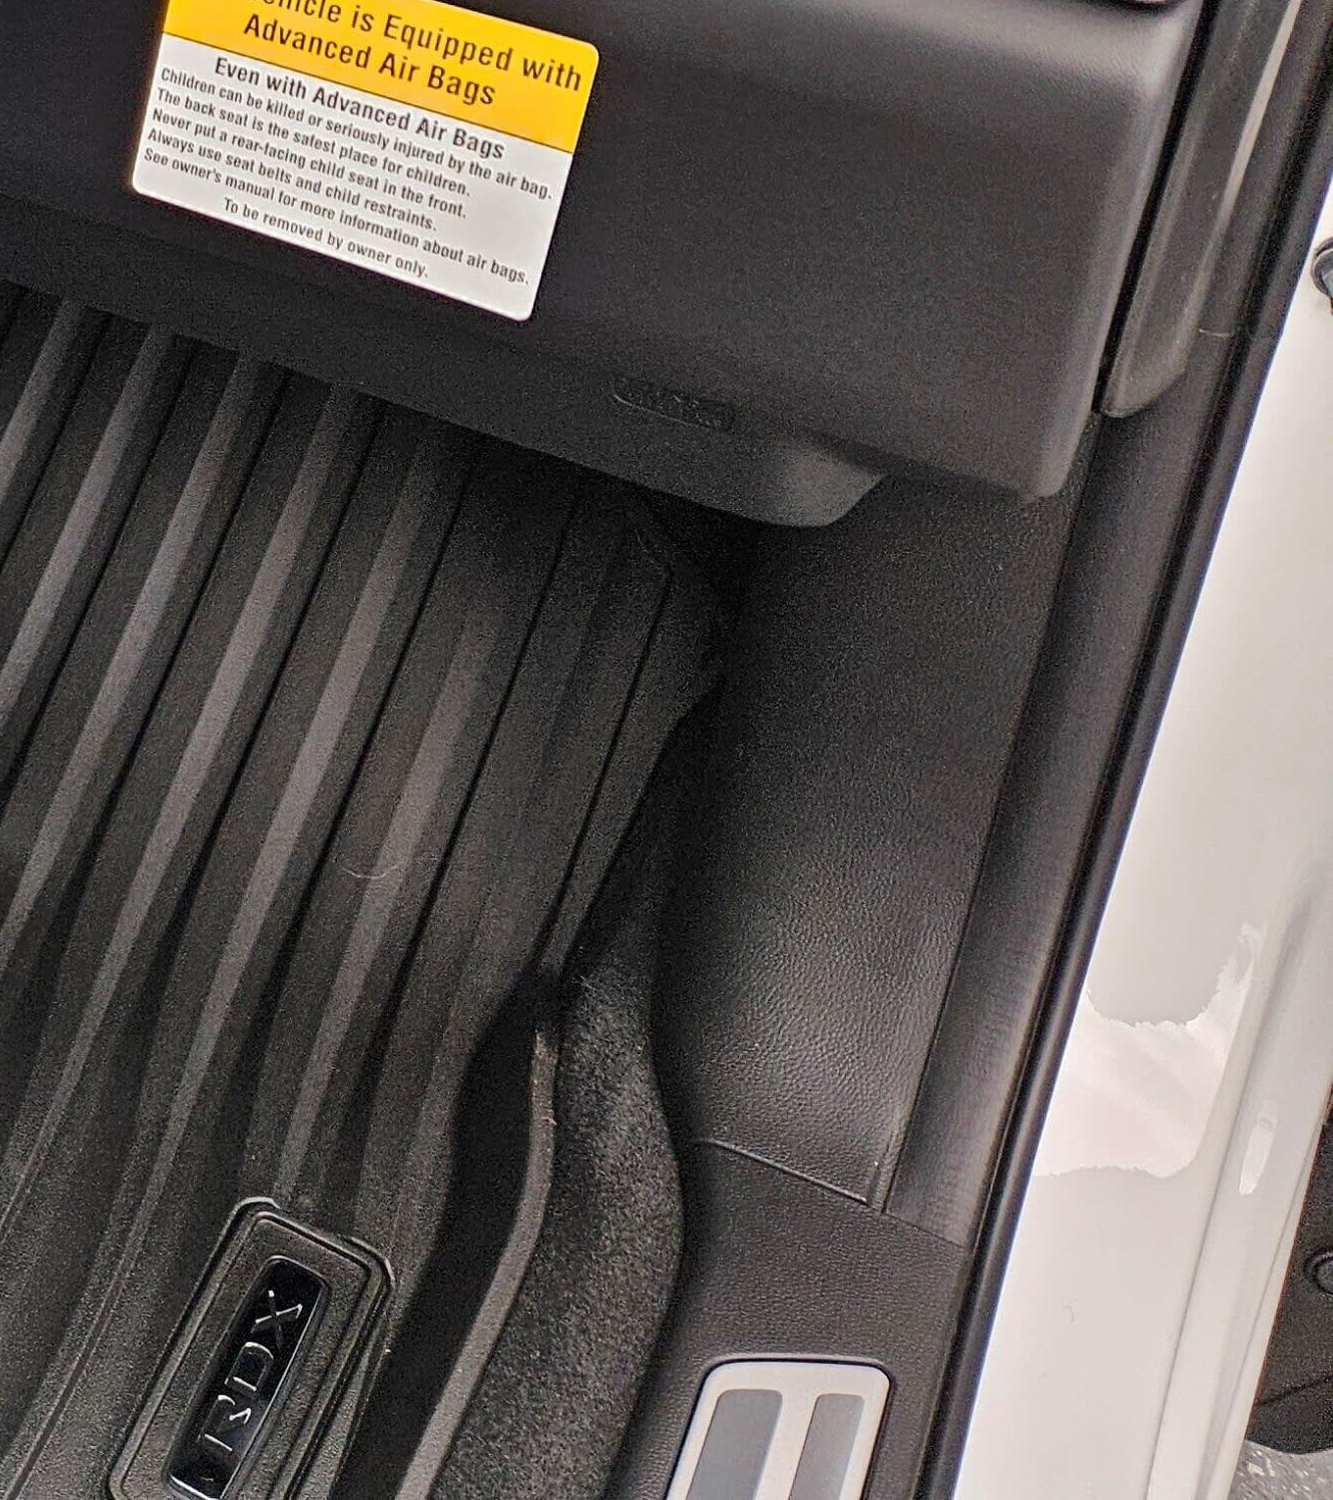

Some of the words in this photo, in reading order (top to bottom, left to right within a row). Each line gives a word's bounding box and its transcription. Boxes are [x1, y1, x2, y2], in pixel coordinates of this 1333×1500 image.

[244, 14, 372, 69] Advanced
[378, 52, 420, 82] Air
[427, 65, 496, 106] Bags
[351, 5, 375, 32] is
[384, 14, 513, 71] Equipped
[522, 57, 581, 91] with
[157, 87, 181, 106] The
[185, 96, 216, 117] back
[219, 108, 249, 128] seat
[252, 117, 264, 132] is
[268, 121, 289, 139] the
[293, 130, 335, 154] safest
[339, 145, 378, 167] place
[383, 157, 403, 175] for
[406, 164, 470, 197] children.
[161, 67, 216, 95] Children
[219, 85, 243, 103] can
[247, 92, 263, 109] be
[266, 98, 304, 122] killed
[308, 114, 323, 127] or
[325, 120, 390, 150] seriously
[393, 137, 445, 166] injured
[448, 152, 465, 173] by
[468, 161, 492, 180] the
[496, 170, 517, 187] air
[520, 177, 552, 200] bag.
[215, 57, 260, 86] Even
[266, 74, 306, 99] with
[312, 86, 411, 131] Advanced
[416, 117, 447, 142] Air
[452, 127, 505, 160] Bags
[144, 147, 168, 166] See
[172, 156, 222, 184] owner's
[225, 174, 275, 200] manual
[278, 185, 297, 207] for
[300, 200, 335, 220] more
[339, 209, 419, 248] information
[423, 239, 464, 263] about
[467, 254, 488, 270] air
[490, 259, 529, 285] bags.
[148, 127, 195, 154] Always
[198, 143, 222, 162] use
[225, 153, 255, 172] seat
[258, 161, 291, 184] belts
[295, 175, 322, 194] and
[326, 184, 360, 206] child
[363, 197, 437, 232] restraints.
[152, 108, 191, 131] Never
[194, 121, 216, 138] put
[219, 130, 228, 142] a
[231, 134, 306, 170] rear-facing
[310, 157, 345, 180] child
[349, 169, 379, 190] seat
[383, 178, 397, 195] in
[401, 182, 424, 203] the
[428, 194, 467, 219] front.
[224, 196, 239, 214] To
[242, 203, 260, 220] be
[263, 210, 323, 241] removed
[327, 231, 343, 250] by
[347, 240, 392, 265] owner
[395, 255, 428, 277] only.
[196, 1288, 304, 1453] RDX
